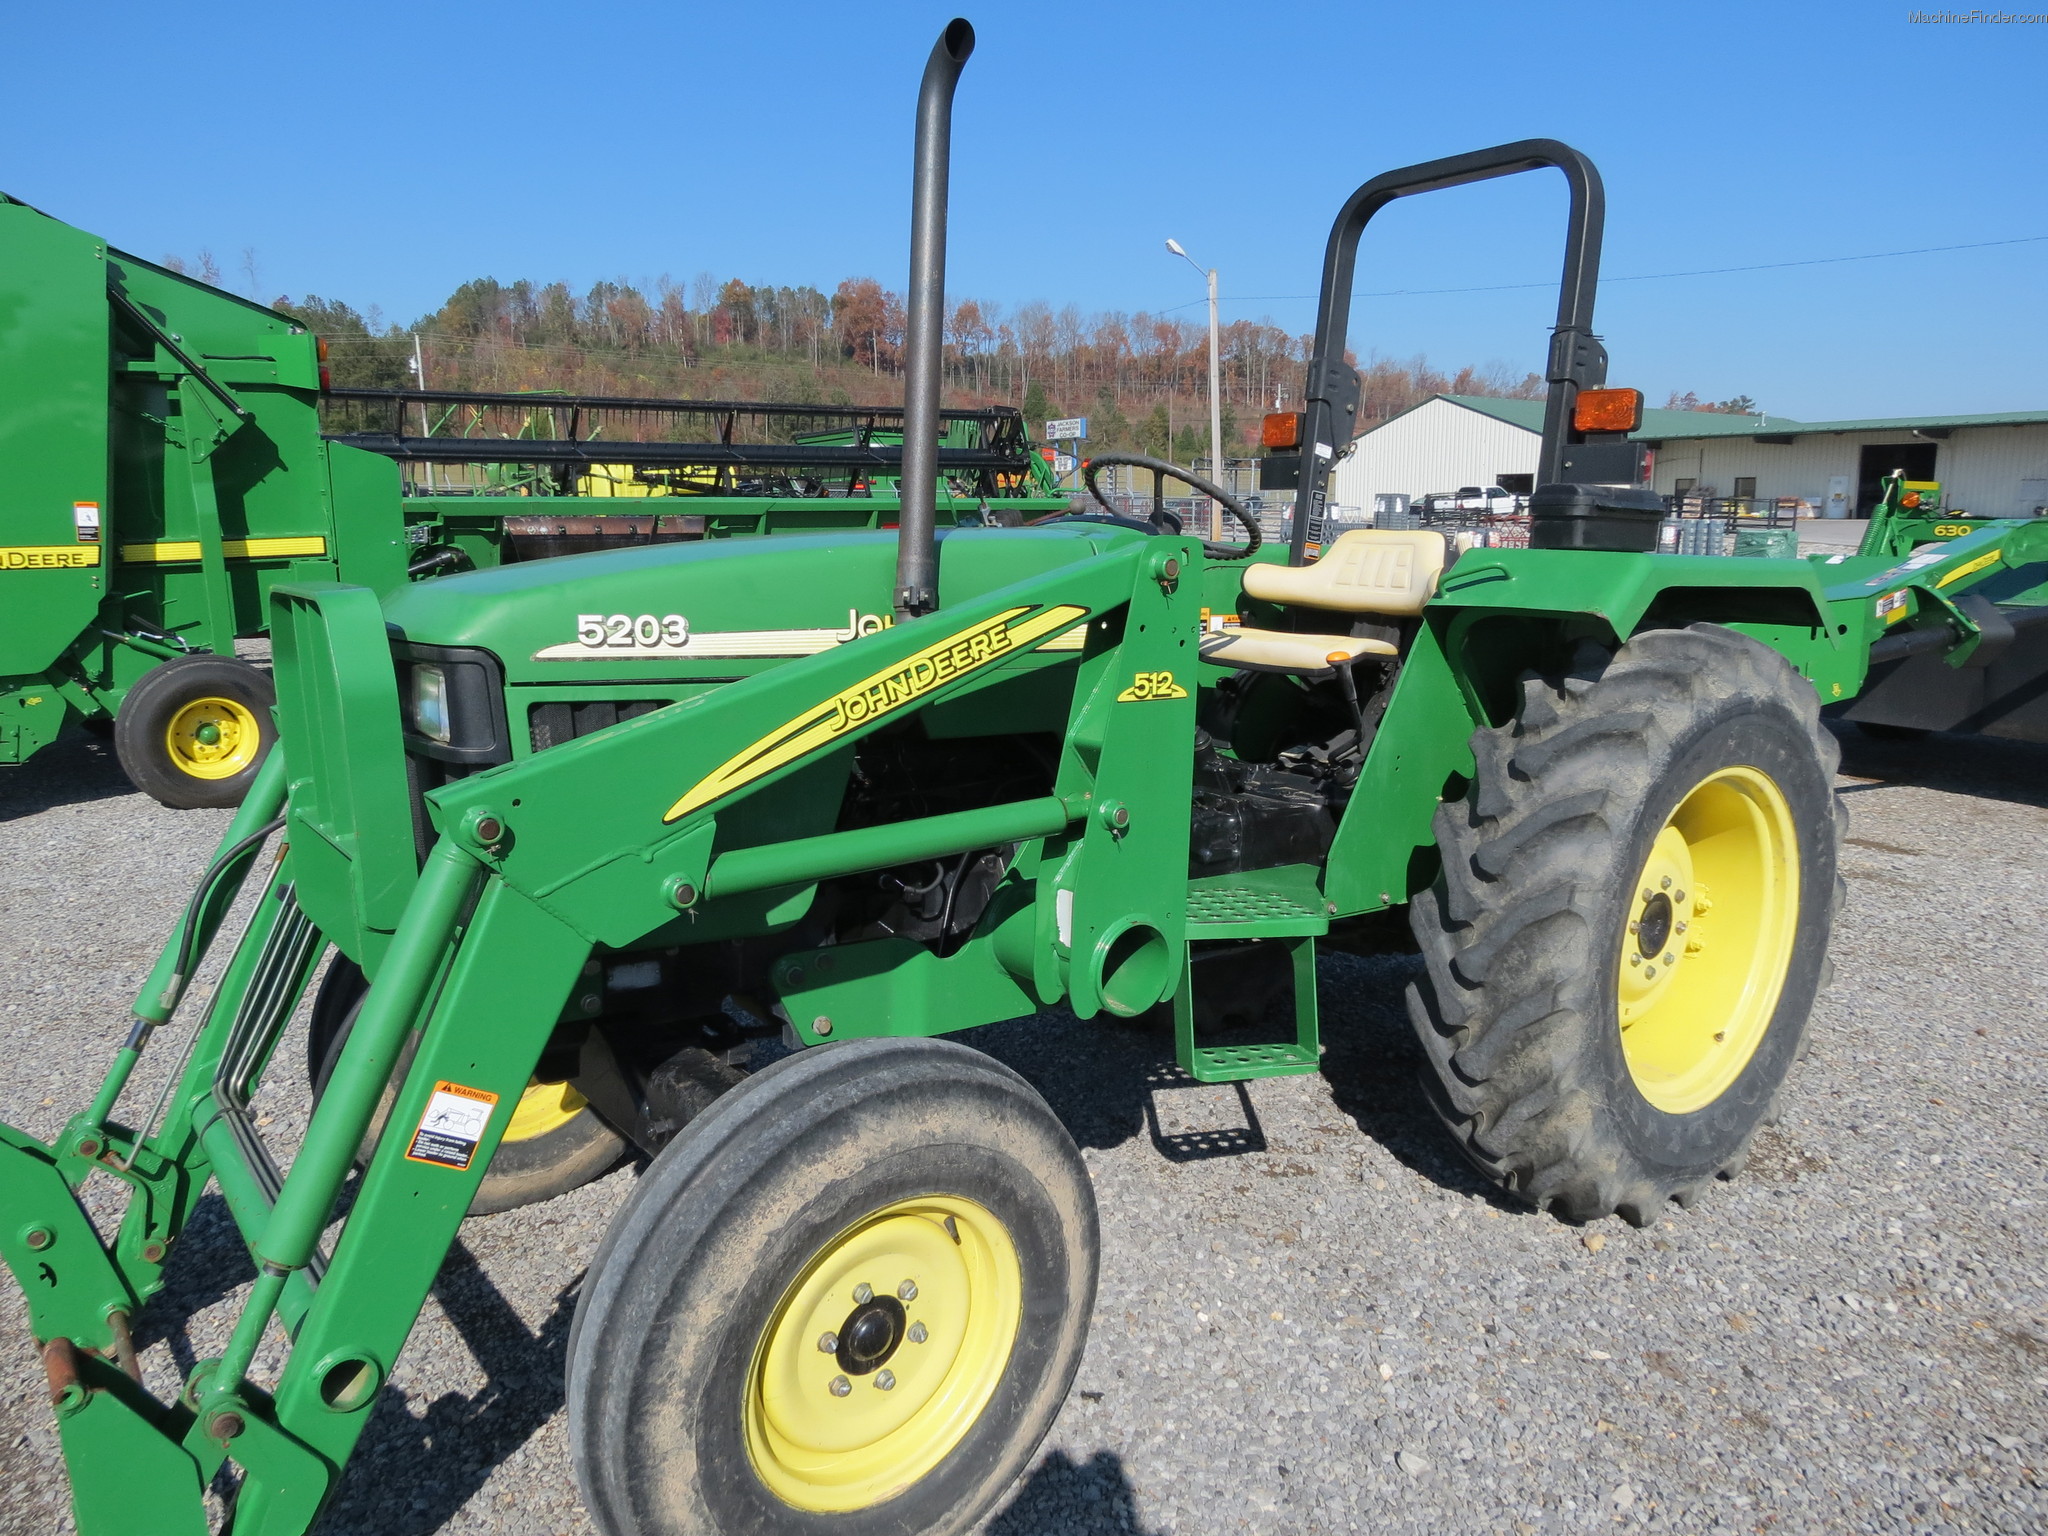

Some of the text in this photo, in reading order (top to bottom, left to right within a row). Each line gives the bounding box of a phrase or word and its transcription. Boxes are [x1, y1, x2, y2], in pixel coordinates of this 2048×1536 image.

[1934, 525, 1971, 537] 630
[8, 552, 85, 567] DEERE
[577, 614, 690, 648] 5203
[830, 623, 1013, 732] JOHN DEERE
[1134, 671, 1174, 699] 512
[455, 1086, 492, 1102] WARNING
